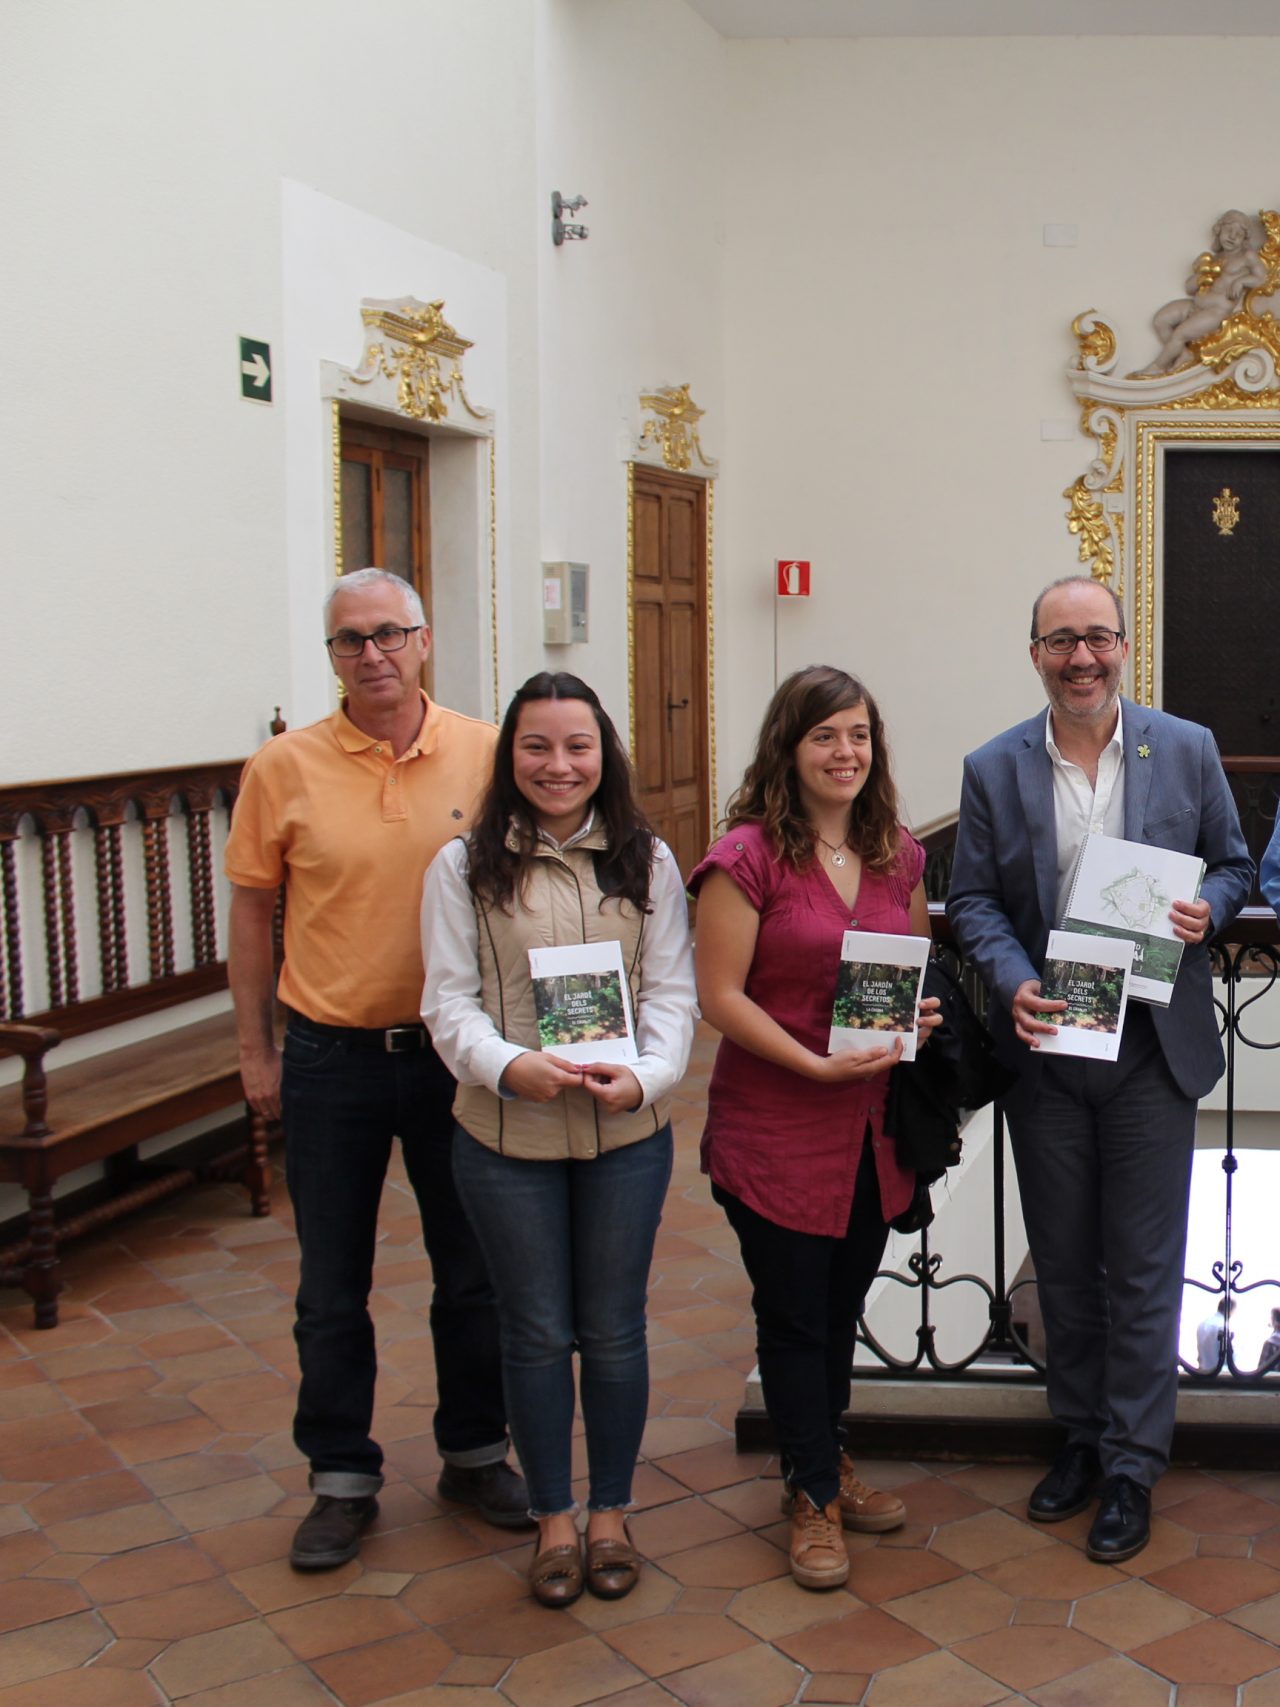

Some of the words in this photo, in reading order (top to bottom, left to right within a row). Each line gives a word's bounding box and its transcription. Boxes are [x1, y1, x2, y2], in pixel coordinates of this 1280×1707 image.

[862, 980, 870, 988] EL
[871, 980, 893, 989] JARDÍN
[875, 988, 887, 996] LOS
[1073, 987, 1088, 996] DELS
[861, 994, 890, 1004] SECRETOS
[1067, 994, 1092, 1004] SECRETS
[567, 1006, 593, 1015] SECRETS
